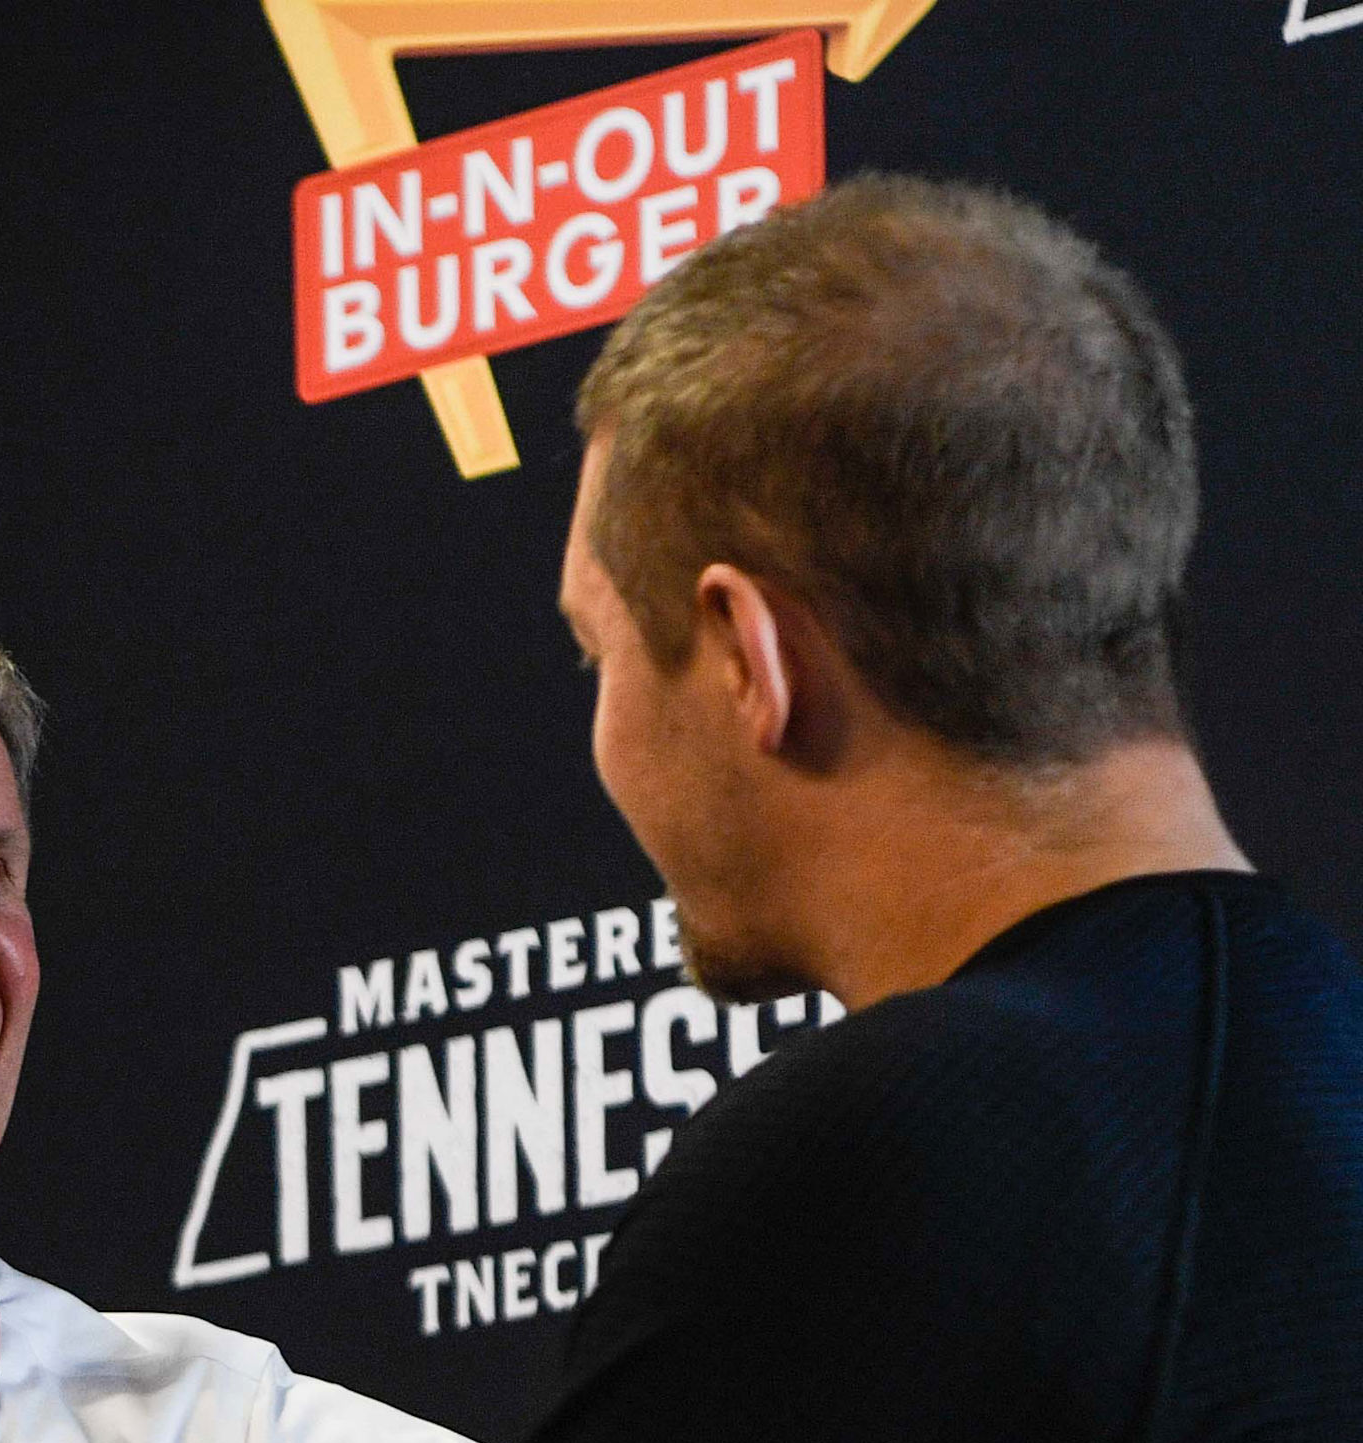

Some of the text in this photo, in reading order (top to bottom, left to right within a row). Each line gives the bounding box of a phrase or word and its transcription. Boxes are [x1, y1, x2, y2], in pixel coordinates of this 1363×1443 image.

[320, 58, 796, 279] IN-N-OUT
[337, 897, 684, 1037] MASTERE
[256, 985, 848, 1266] TENNES
